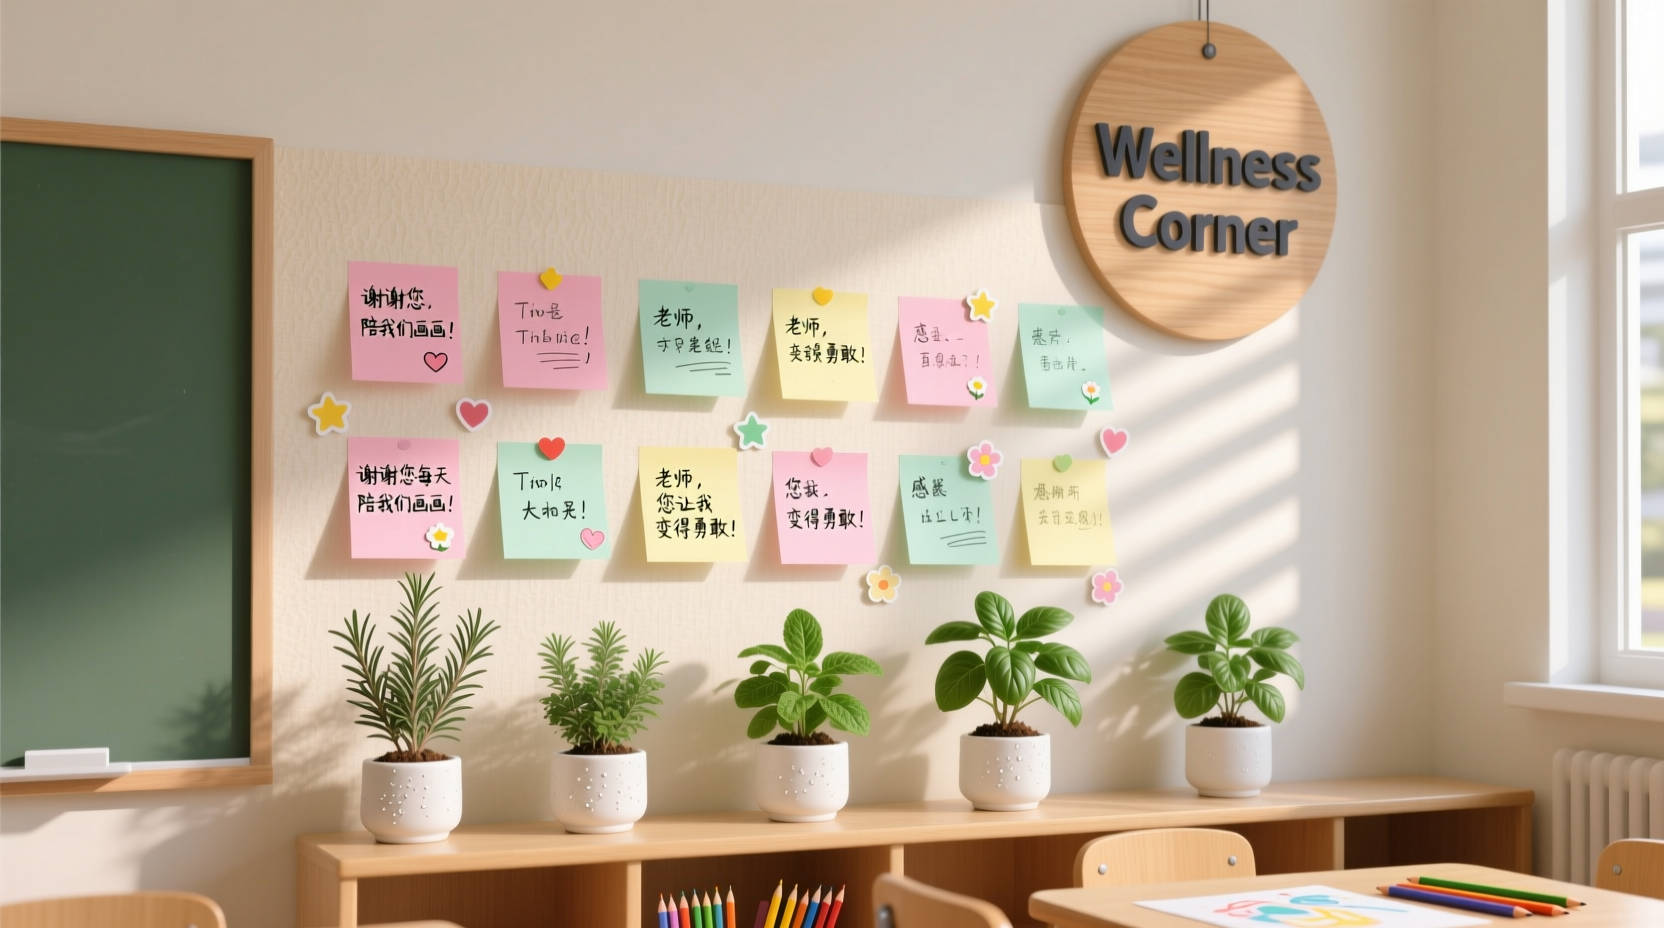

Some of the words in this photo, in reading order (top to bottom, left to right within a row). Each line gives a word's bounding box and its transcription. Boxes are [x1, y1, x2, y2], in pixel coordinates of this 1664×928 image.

[1095, 122, 1321, 193] Wellness
[1119, 194, 1299, 256] Corner
[653, 304, 702, 331] 老师，
[785, 314, 828, 338] 老师，
[655, 467, 702, 490] 老师，
[656, 492, 713, 515] 您让我
[655, 516, 736, 540] 变得勇敢！
[786, 507, 864, 531] 变得勇敢！
